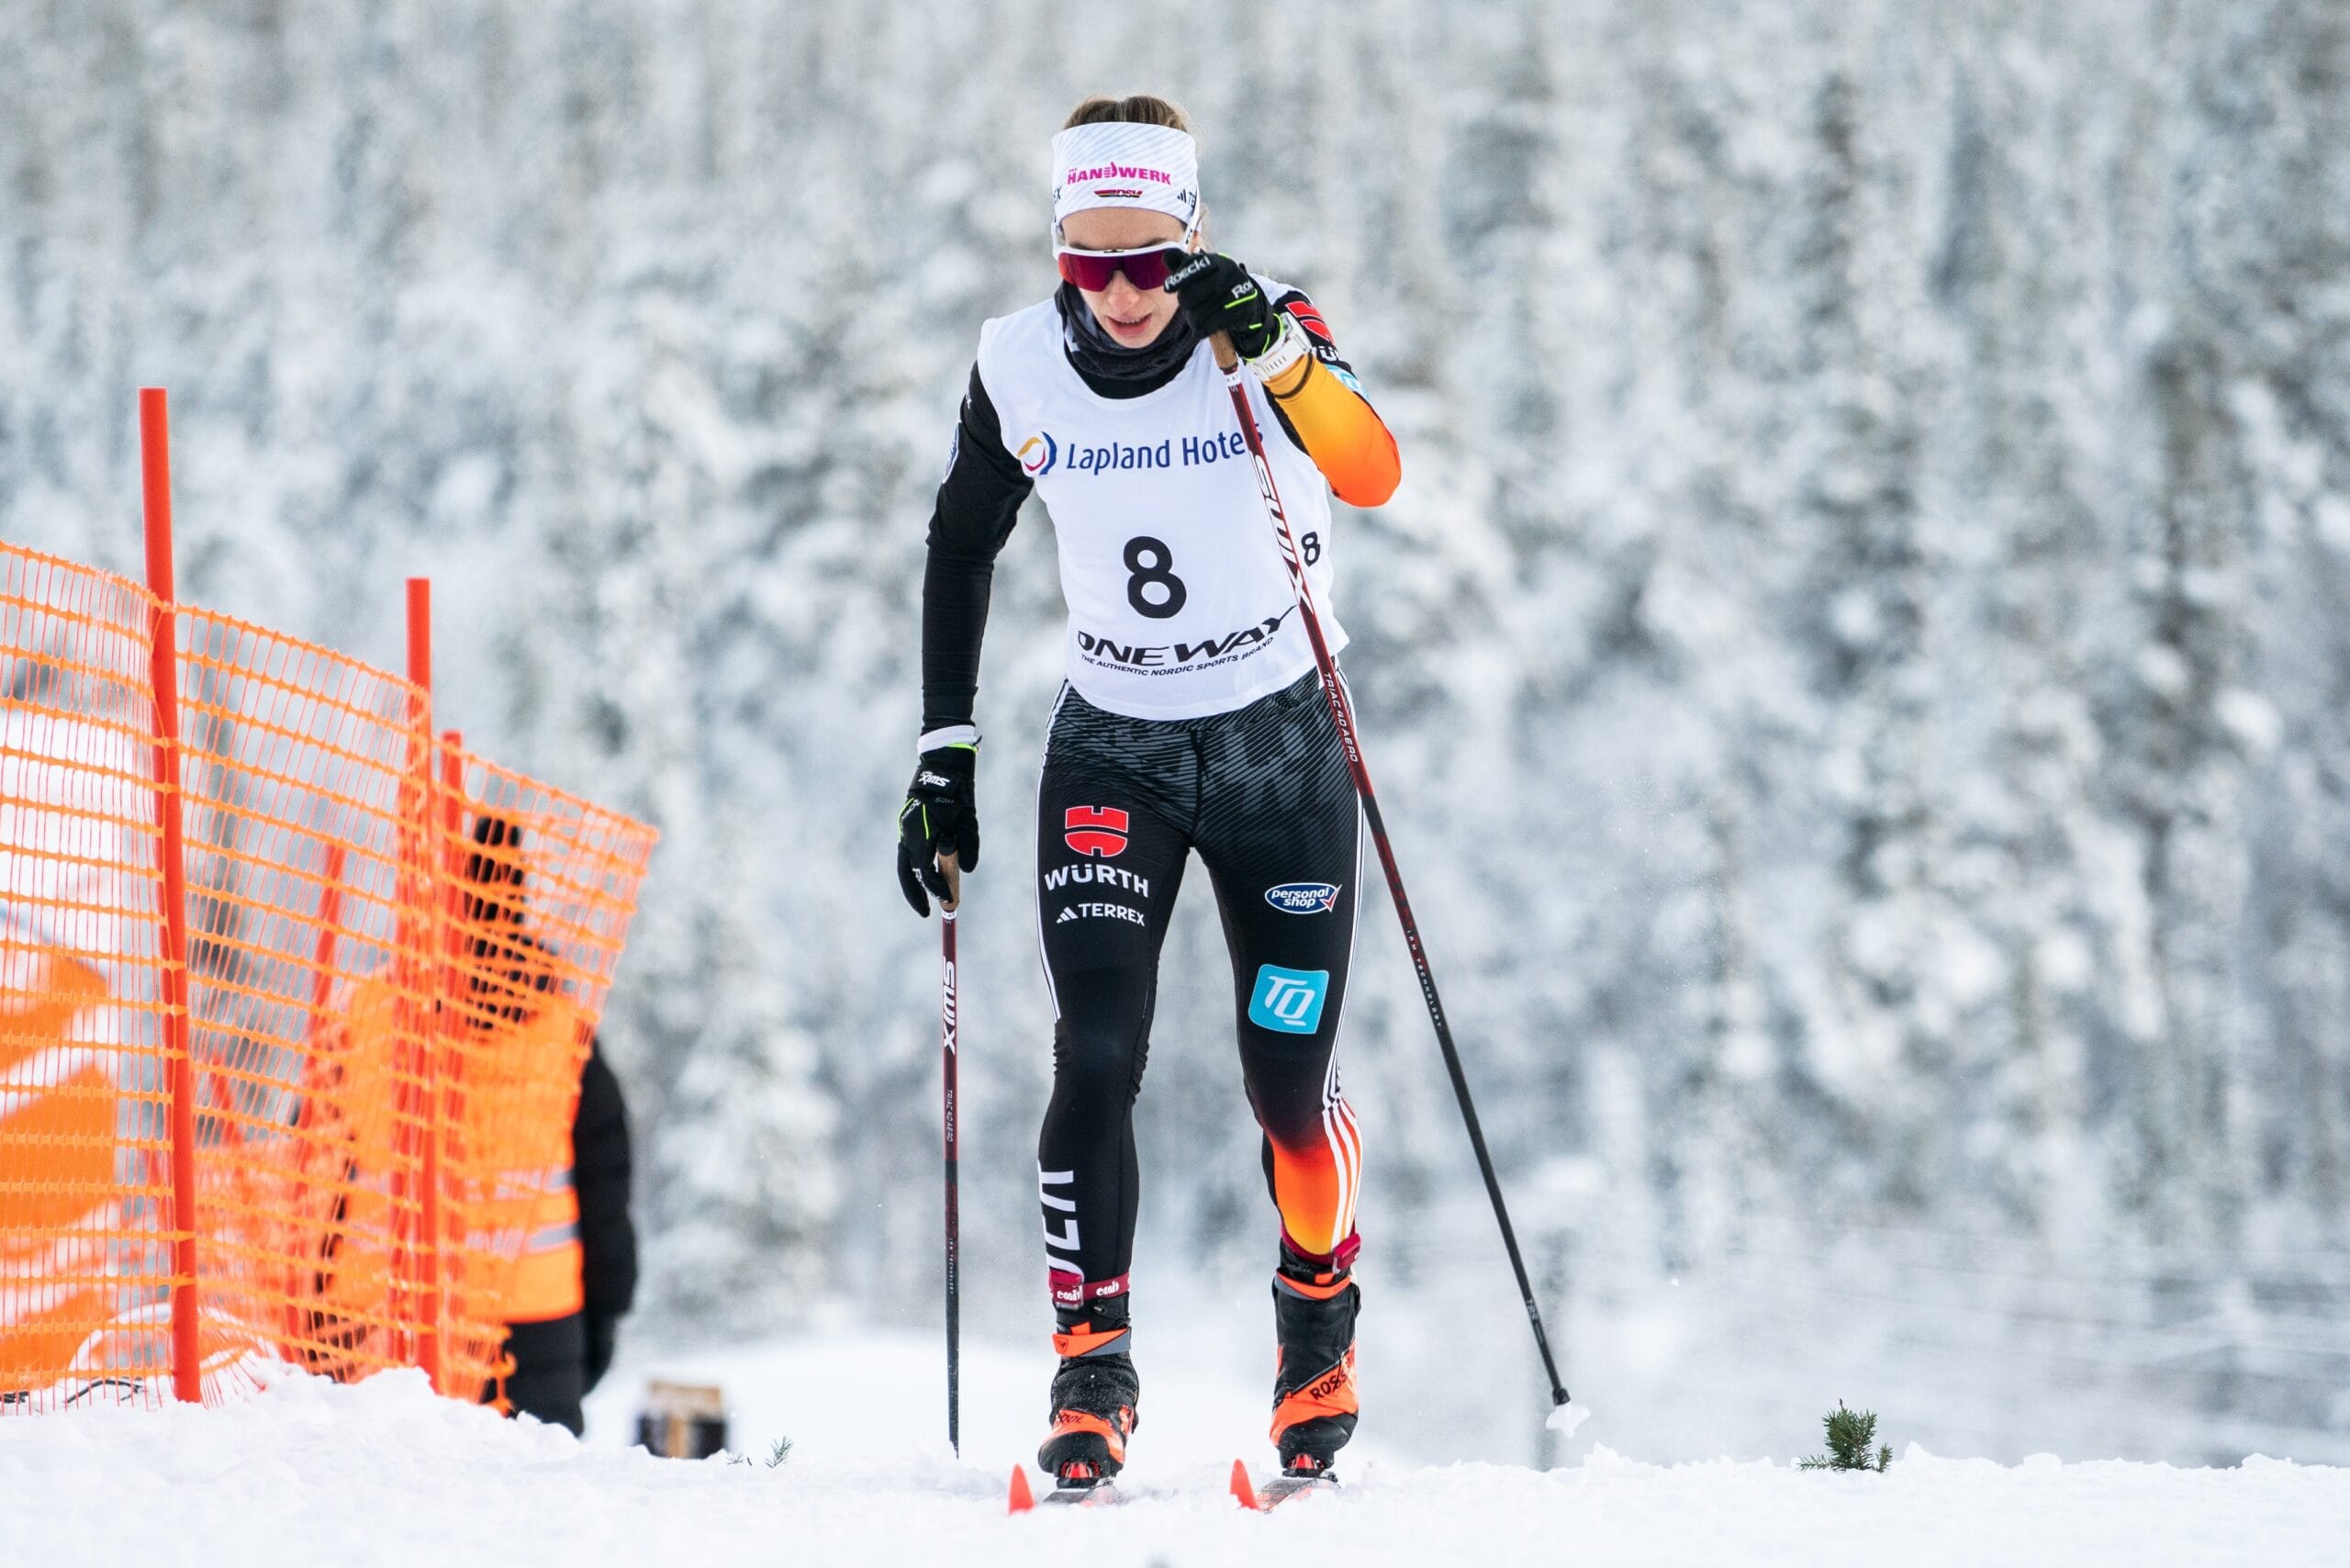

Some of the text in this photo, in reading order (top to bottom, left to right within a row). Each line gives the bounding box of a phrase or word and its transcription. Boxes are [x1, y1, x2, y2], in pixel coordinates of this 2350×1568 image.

[1066, 442, 1170, 476] Lapland
[1301, 531, 1321, 567] 8
[1123, 535, 1187, 619] 8
[1081, 636, 1274, 677] THE AUTHENTIC NORDIC SPORTS BRAND
[1044, 863, 1149, 898] WÜRTH
[1270, 887, 1329, 901] personal
[1077, 902, 1146, 927] TERREX
[1282, 896, 1316, 909] shop
[942, 957, 956, 1056] SWIX
[1263, 975, 1316, 1026] TQ
